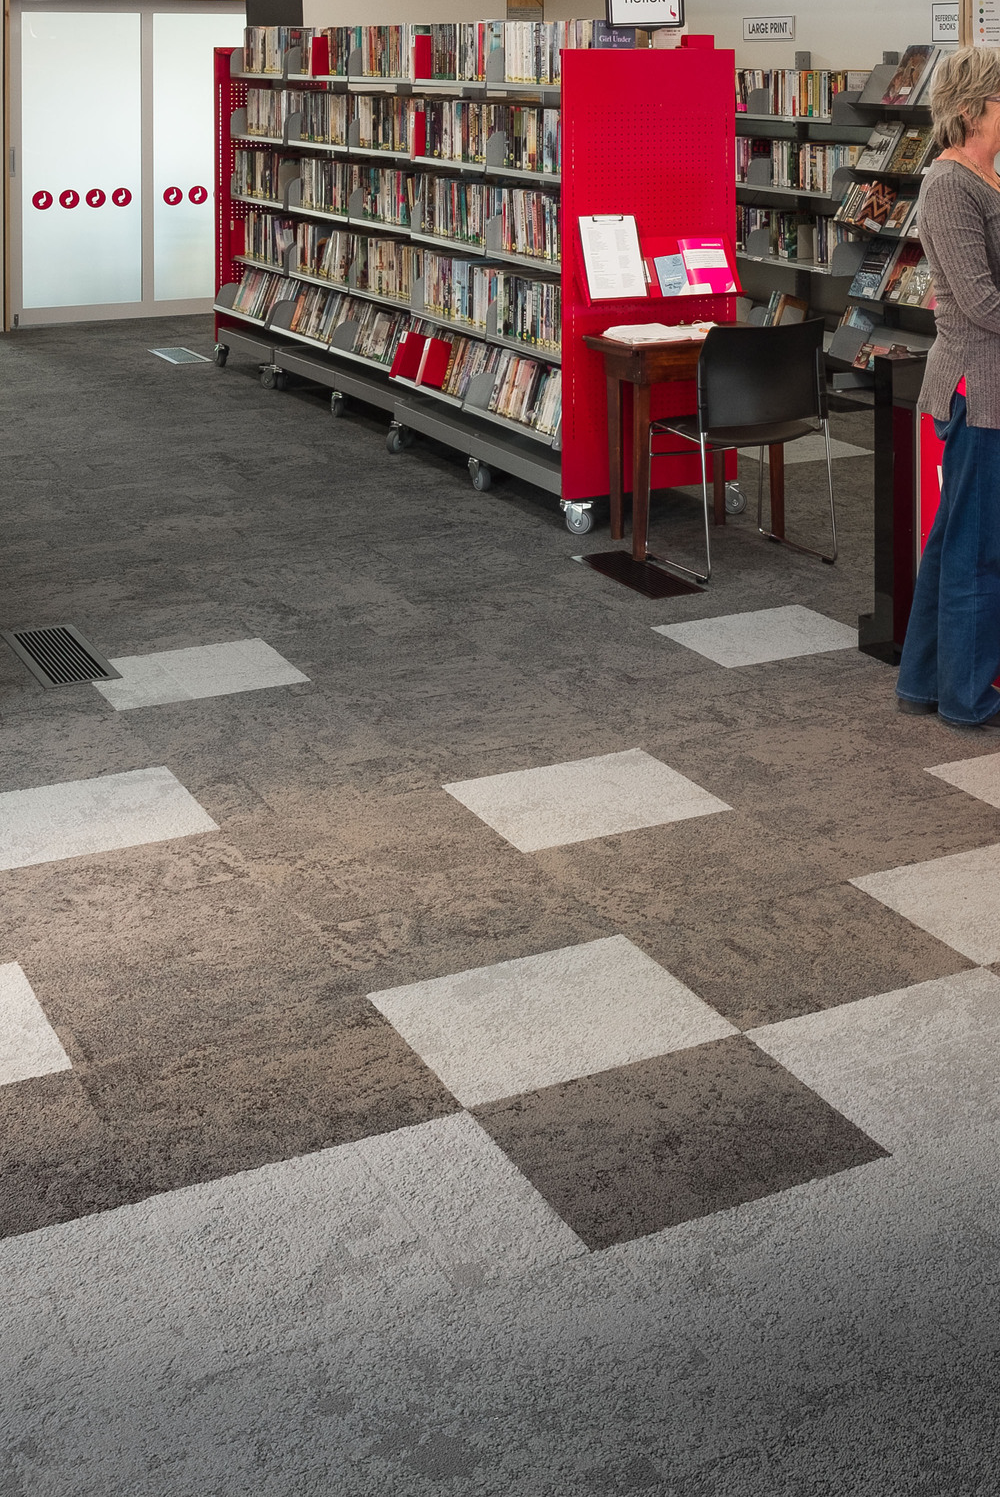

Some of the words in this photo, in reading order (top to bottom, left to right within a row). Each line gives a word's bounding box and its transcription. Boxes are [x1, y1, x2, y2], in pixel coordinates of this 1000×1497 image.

[748, 23, 769, 34] LARGE
[769, 22, 788, 33] PRINT
[939, 23, 956, 31] BOOKS
